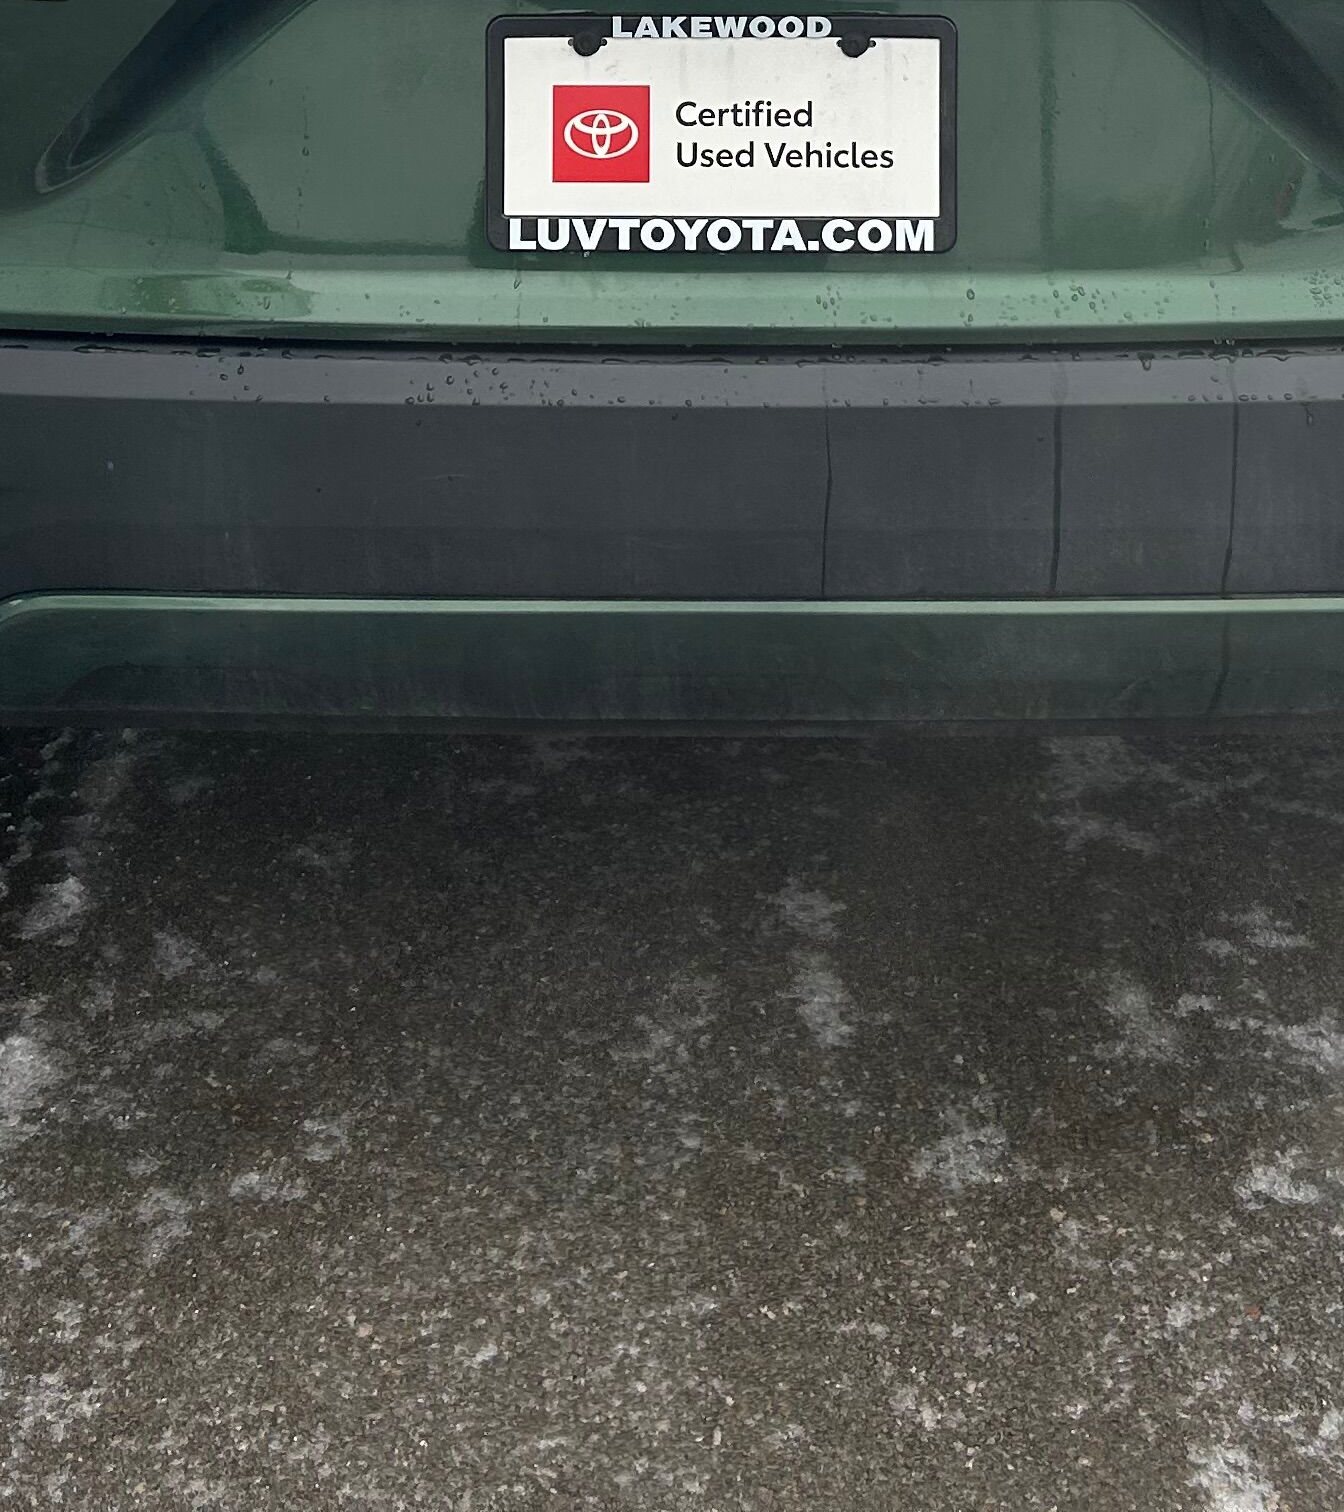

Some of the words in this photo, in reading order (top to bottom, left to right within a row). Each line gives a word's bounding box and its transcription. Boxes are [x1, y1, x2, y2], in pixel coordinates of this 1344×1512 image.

[612, 16, 833, 39] LAKEWOOD
[675, 100, 813, 127] Certified
[676, 142, 754, 168] Used
[764, 141, 895, 169] Vehicles
[509, 219, 935, 252] LUVTOYOTA.COM
